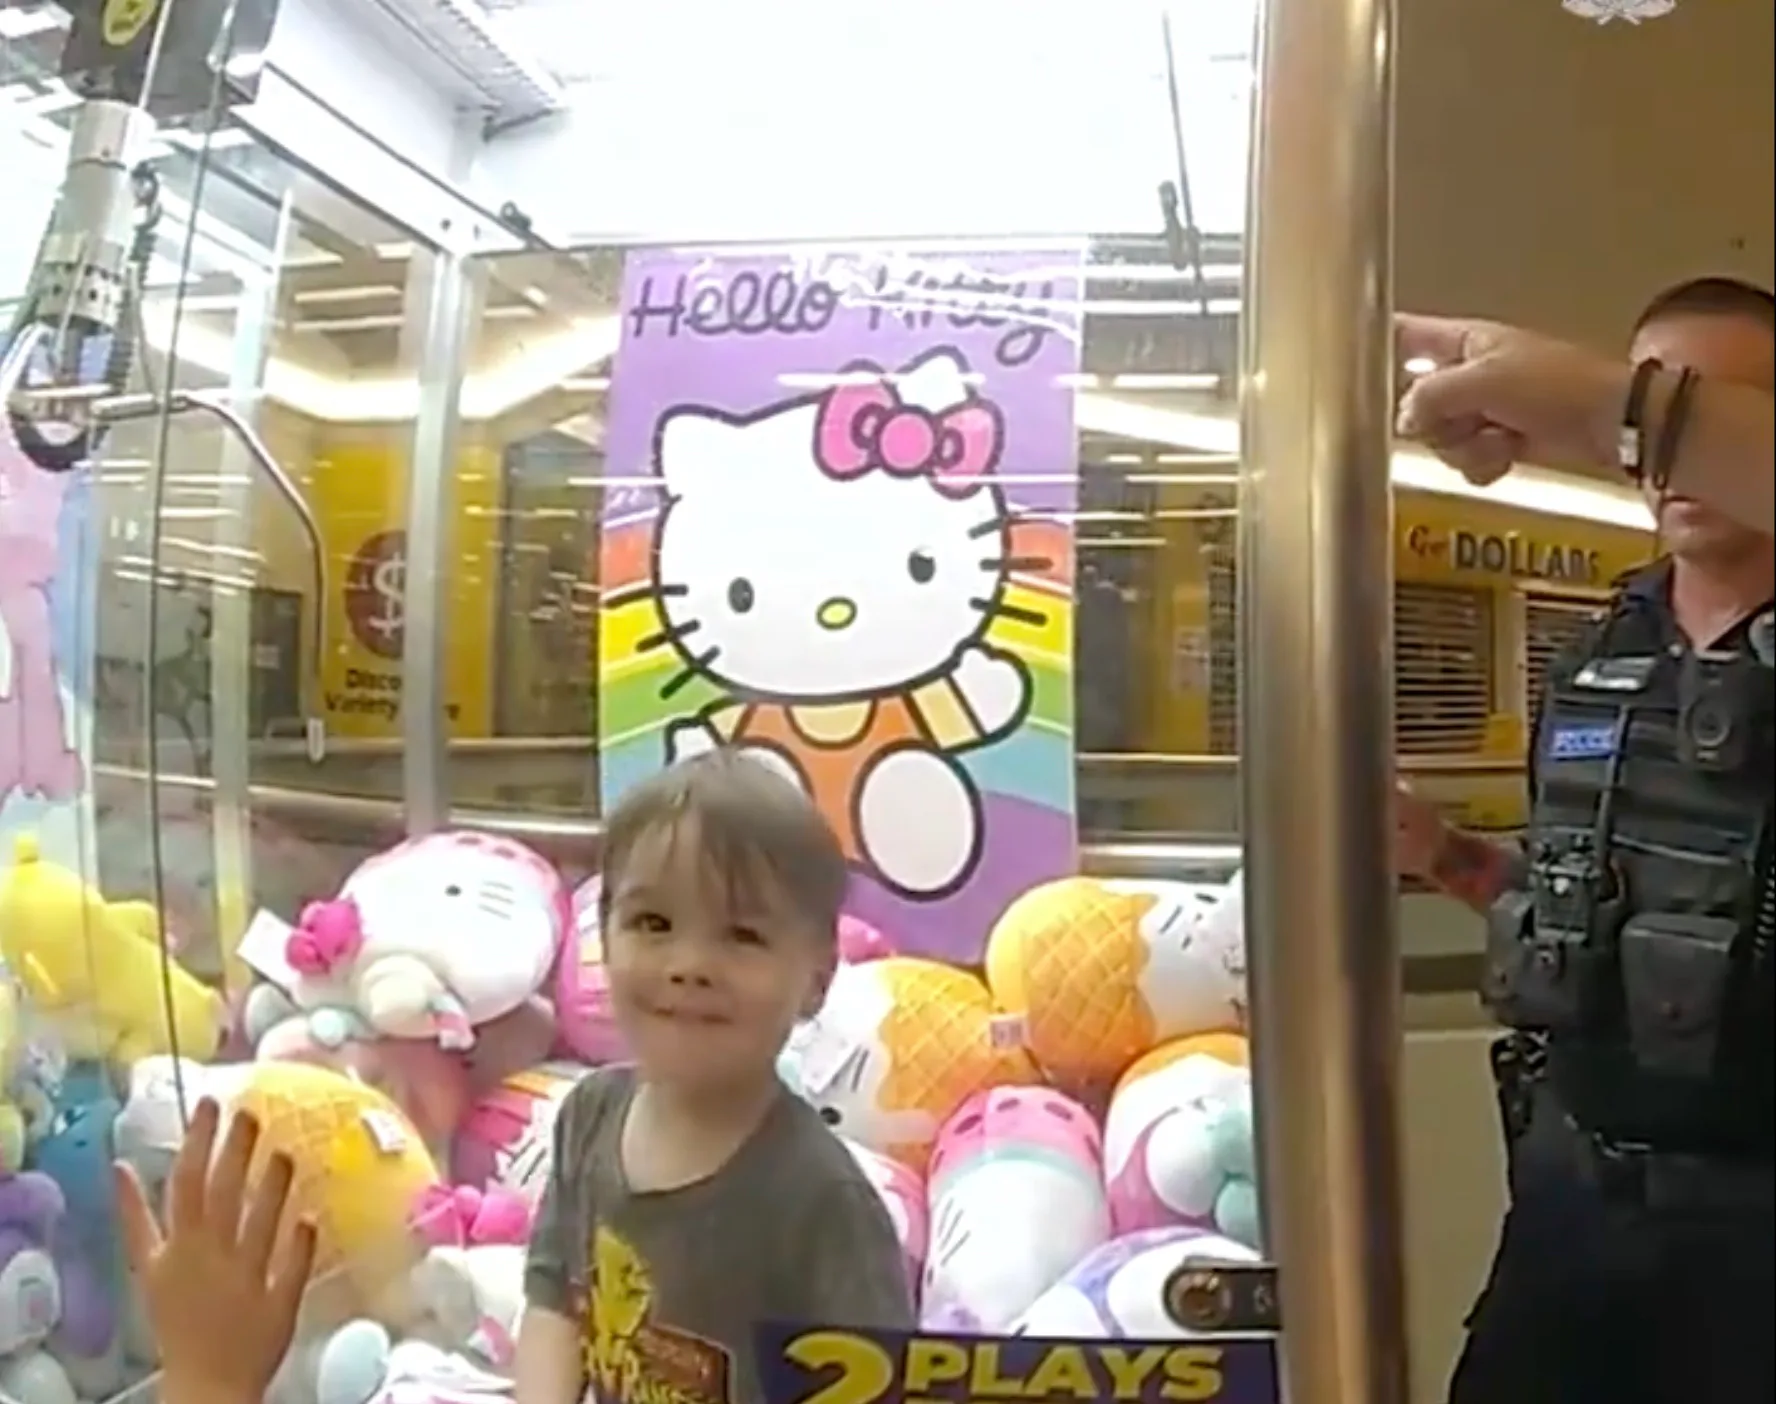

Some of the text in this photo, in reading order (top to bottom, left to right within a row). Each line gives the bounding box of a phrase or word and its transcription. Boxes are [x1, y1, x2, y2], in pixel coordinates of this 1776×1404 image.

[630, 270, 838, 338] Hello
[784, 1331, 893, 1404] 2
[905, 1339, 1223, 1399] PLAYS
